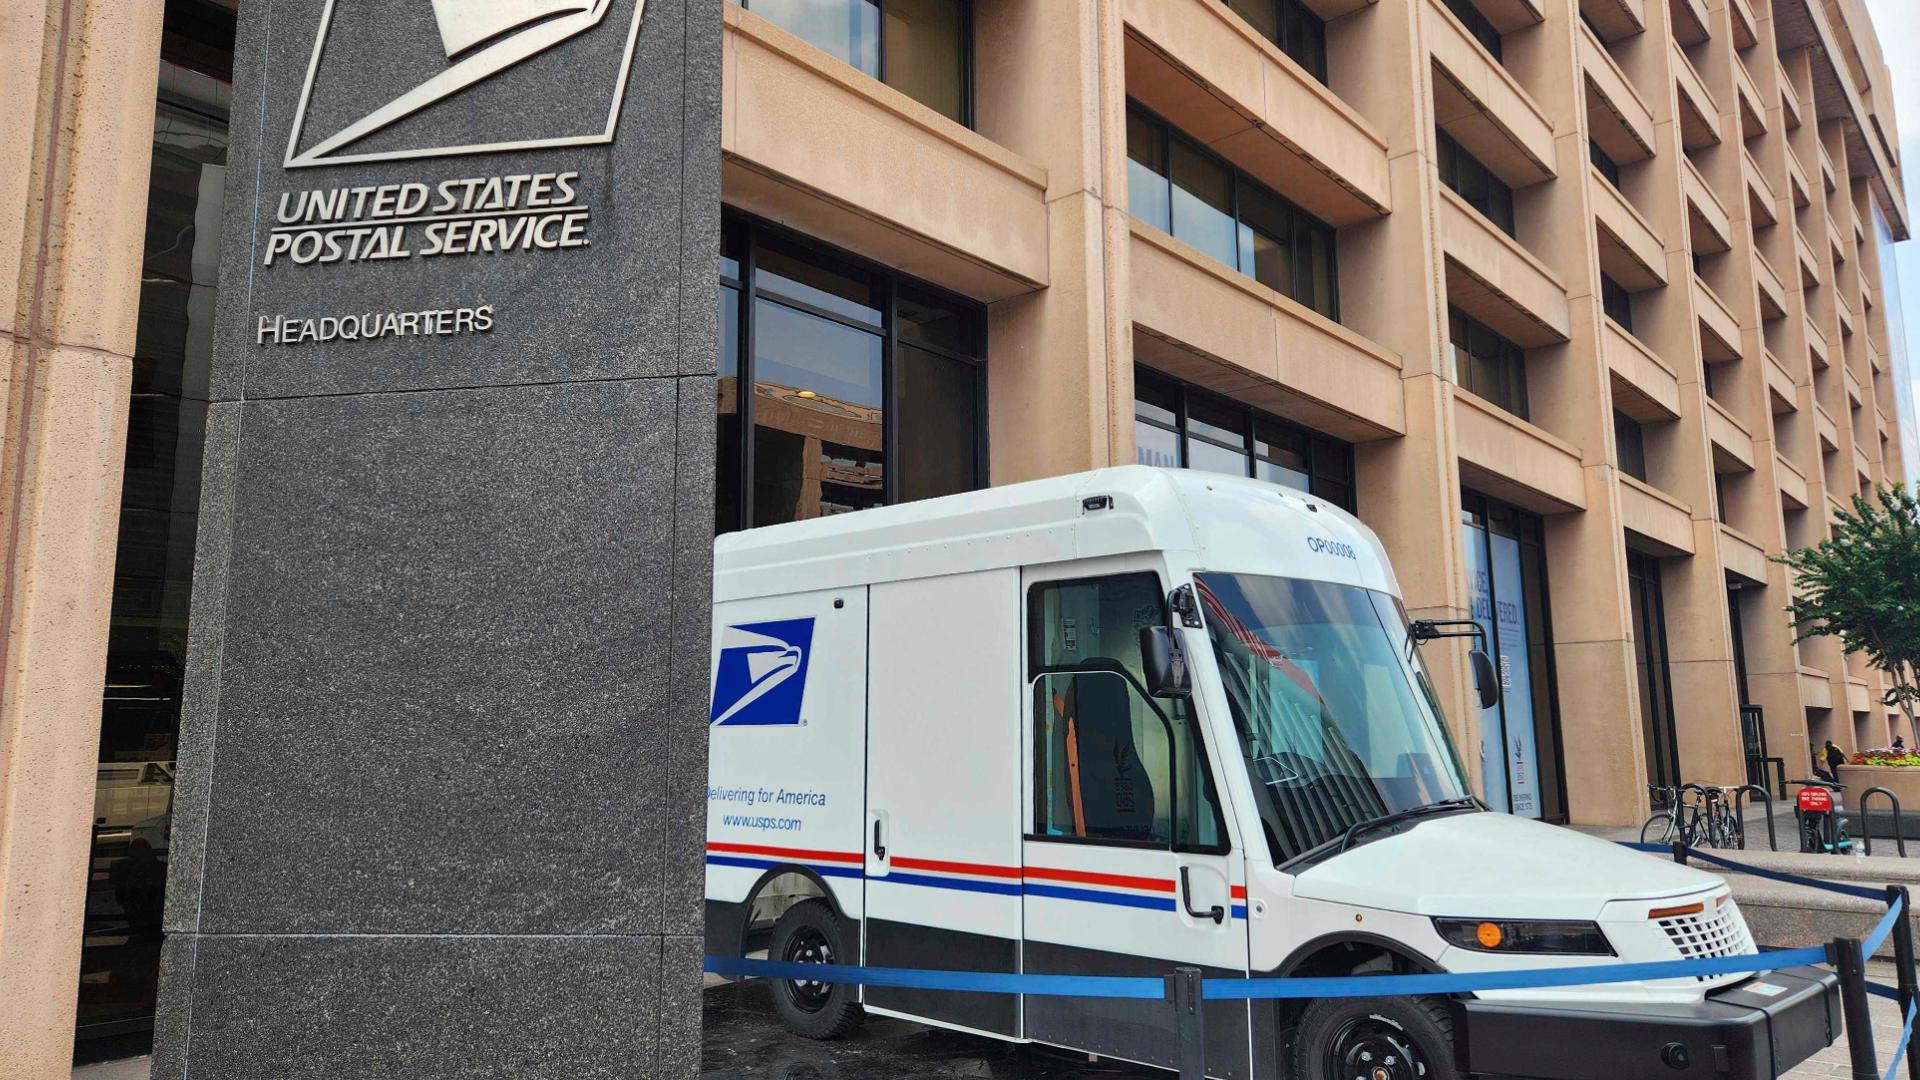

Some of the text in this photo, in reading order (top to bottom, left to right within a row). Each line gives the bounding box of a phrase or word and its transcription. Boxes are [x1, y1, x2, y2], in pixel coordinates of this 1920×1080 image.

[277, 171, 579, 225] UNITED STATES
[264, 226, 411, 266] POSTAL
[257, 304, 494, 345] HEADQUARTERS
[758, 787, 774, 803] for
[777, 788, 826, 806] America
[723, 814, 801, 831] www.usps.com
